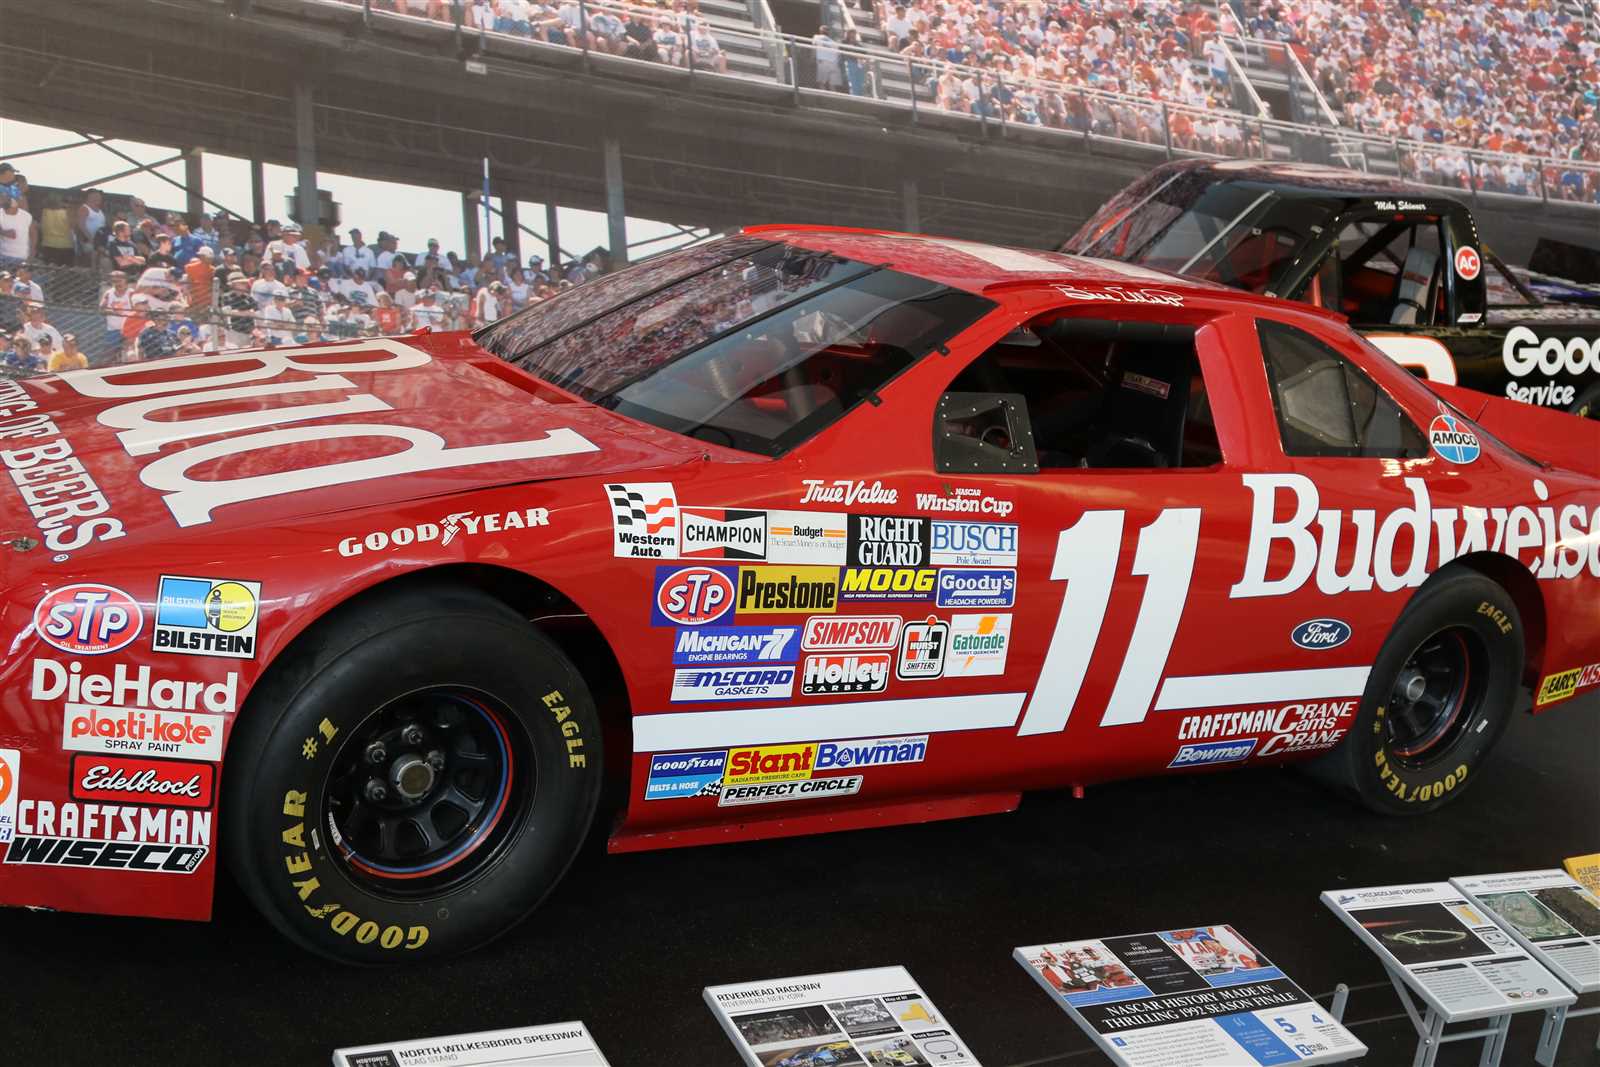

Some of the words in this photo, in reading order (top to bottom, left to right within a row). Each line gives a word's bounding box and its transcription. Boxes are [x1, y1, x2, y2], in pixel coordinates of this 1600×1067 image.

[1459, 255, 1477, 270] AC
[1505, 381, 1576, 406] Service
[62, 338, 600, 528] Bud
[1433, 433, 1477, 446] AMOCO
[0, 438, 127, 551] BEERS
[955, 488, 981, 496] NASCAR
[916, 493, 980, 512] Winston
[981, 496, 1014, 517] Cup
[338, 507, 550, 557] GOODYEAR
[618, 532, 675, 546] Western
[686, 524, 762, 544] CHAMPION
[793, 525, 824, 539] Budget
[859, 516, 923, 542] RIGHT
[932, 524, 1017, 551] BUSCH
[631, 546, 661, 557] Auto
[858, 542, 923, 566] GUARD
[740, 570, 836, 609] Prestone
[842, 568, 937, 592] MOOG
[941, 574, 1013, 594] Goody's
[667, 574, 726, 615] STP
[46, 591, 130, 645] STP
[1016, 507, 1201, 736] 11
[1477, 601, 1513, 635] EAGLE
[156, 630, 253, 654] BILSTEIN
[676, 631, 763, 653] MICHIGAN
[810, 621, 894, 645] SIMPSON
[952, 633, 1005, 651] Gatorade
[1302, 622, 1341, 645] Ford
[714, 653, 748, 661] BEARINGS
[909, 641, 939, 650] HURST
[804, 656, 889, 690] Holley
[906, 662, 936, 670] SHIFTERS
[32, 658, 238, 712] DieHard
[714, 686, 769, 696] GASKETS
[804, 684, 864, 692] CARBS
[72, 709, 213, 744] plasti-kote
[1178, 709, 1277, 740] CRAFTSMAN
[1273, 701, 1358, 733] CRANE
[302, 717, 339, 760] #1
[541, 690, 586, 769] EAGLE
[105, 739, 143, 750] SPRAY
[148, 742, 182, 753] PAINT
[816, 742, 926, 769] Bowman
[1176, 745, 1252, 763] Bowman
[653, 757, 723, 771] GOODYEAR
[729, 746, 812, 776] Stant
[82, 765, 200, 797] Edelbrock
[650, 783, 670, 792] BELTS
[678, 781, 699, 791] HOSE
[725, 783, 798, 799] PERFECT
[800, 778, 858, 792] CIRCLE
[18, 800, 212, 845] CRAFTSMAN
[5, 837, 206, 872] WISECO
[185, 848, 204, 871] PISTON
[282, 790, 430, 950] GOODYEAR
[717, 988, 775, 1001] RIVERHEAD
[775, 982, 822, 996] RACEWAY
[766, 995, 785, 1004] NEW
[786, 992, 806, 1001] YORK
[1106, 1000, 1163, 1016] NASCAR
[1163, 992, 1219, 1009] HISTORY
[1221, 987, 1258, 1001] MADE
[1259, 984, 1276, 995] IN
[1101, 1009, 1179, 1028] THRILLING
[1179, 1004, 1206, 1018] 1992
[1205, 999, 1251, 1014] SEASON
[1251, 992, 1298, 1008] FINALE
[1312, 1013, 1324, 1024] 4
[1274, 1017, 1297, 1033] 5
[399, 1046, 441, 1059] NORTH
[442, 1036, 522, 1053] WILKESBORO
[523, 1029, 584, 1045] SPEEDWAY
[402, 1055, 428, 1066] FLAG
[428, 1053, 458, 1063] STAND
